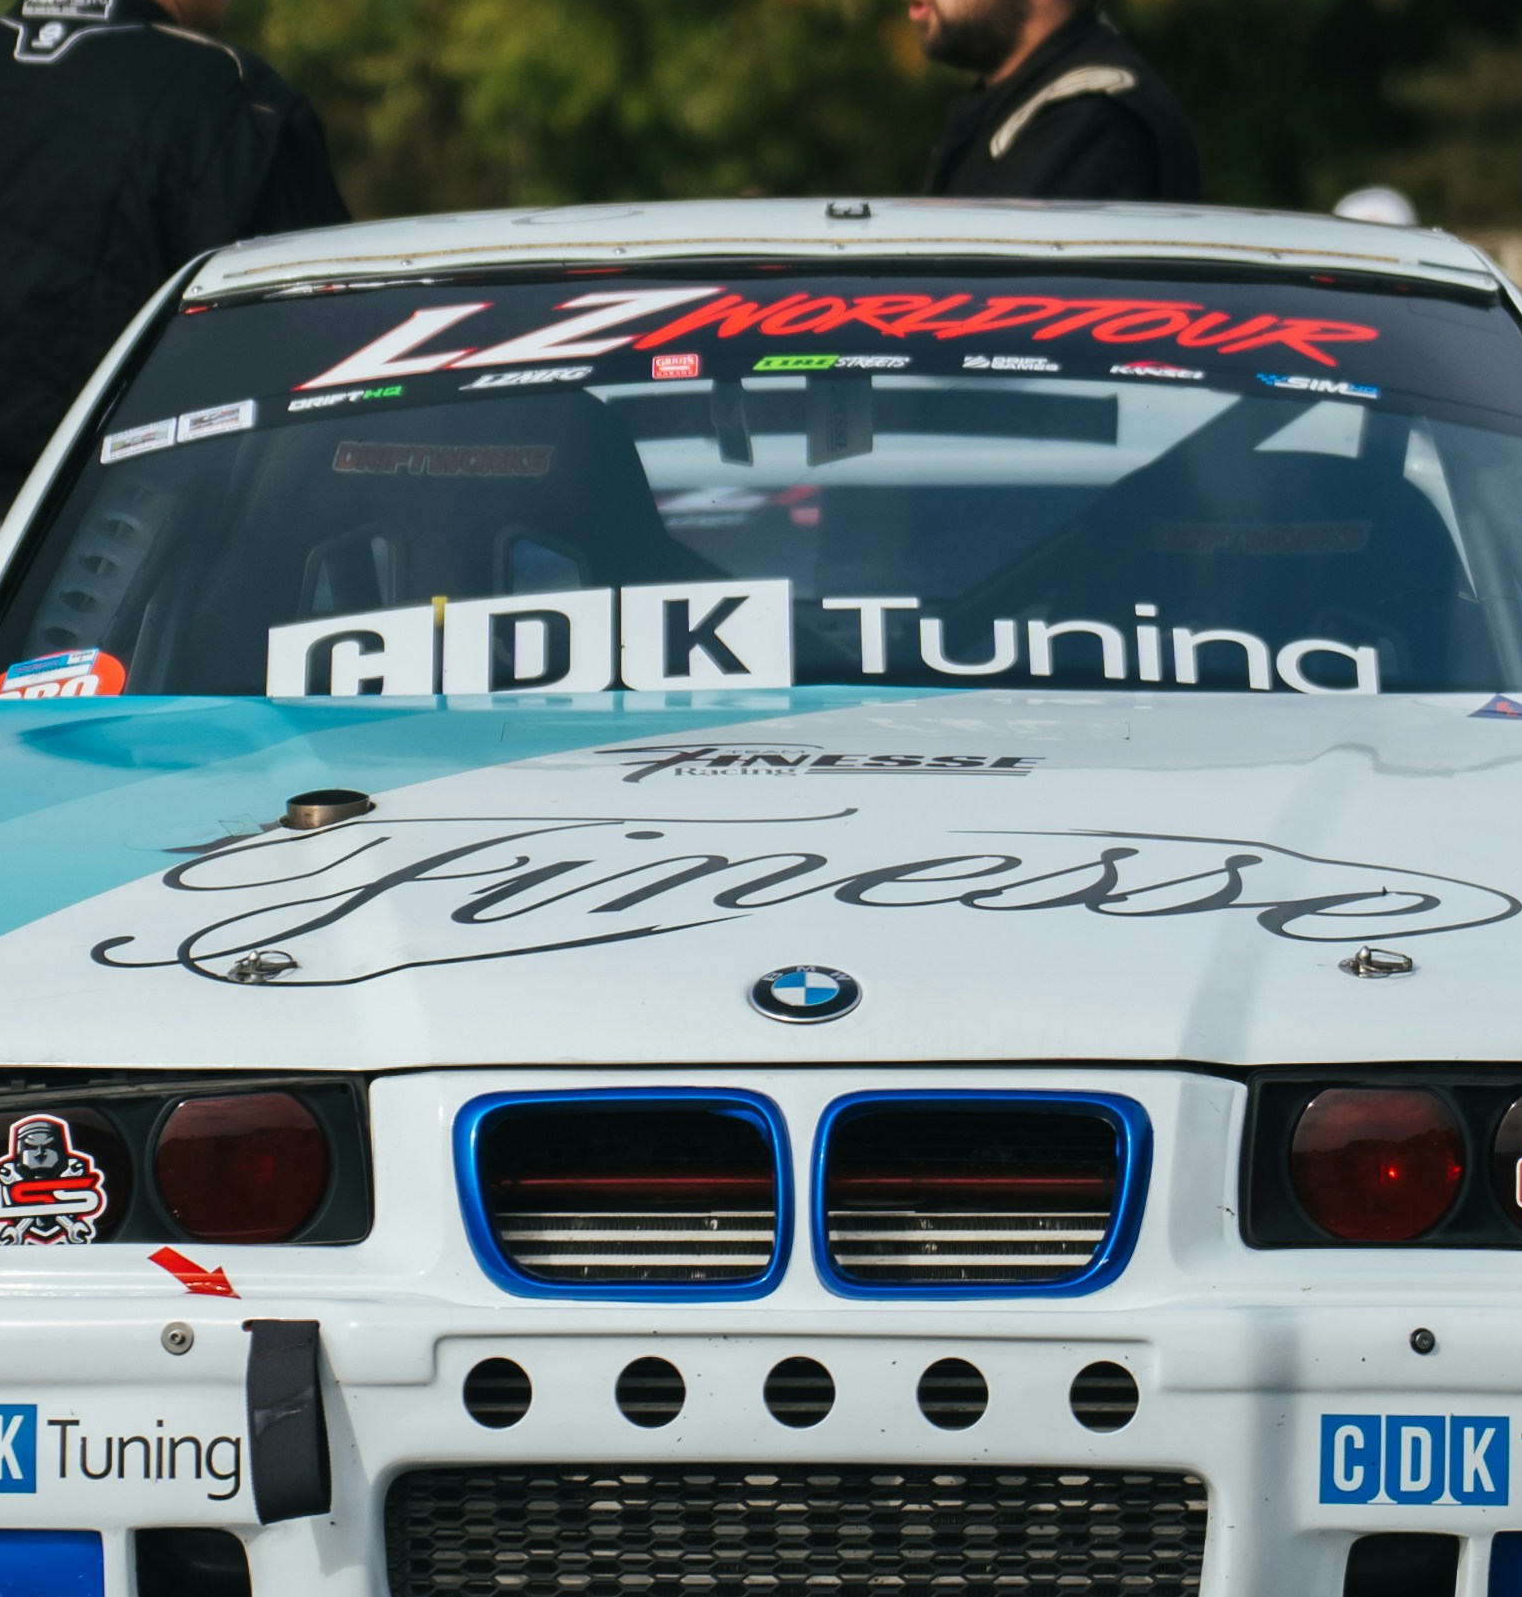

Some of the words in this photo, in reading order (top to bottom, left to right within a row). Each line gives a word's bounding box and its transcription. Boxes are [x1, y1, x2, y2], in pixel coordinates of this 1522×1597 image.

[305, 595, 751, 695] CDK
[674, 766, 797, 777] Racing
[90, 807, 1522, 987] Finesse
[762, 965, 852, 982] BMW
[47, 1419, 241, 1501] Tuning
[1333, 1424, 1496, 1492] CDK
